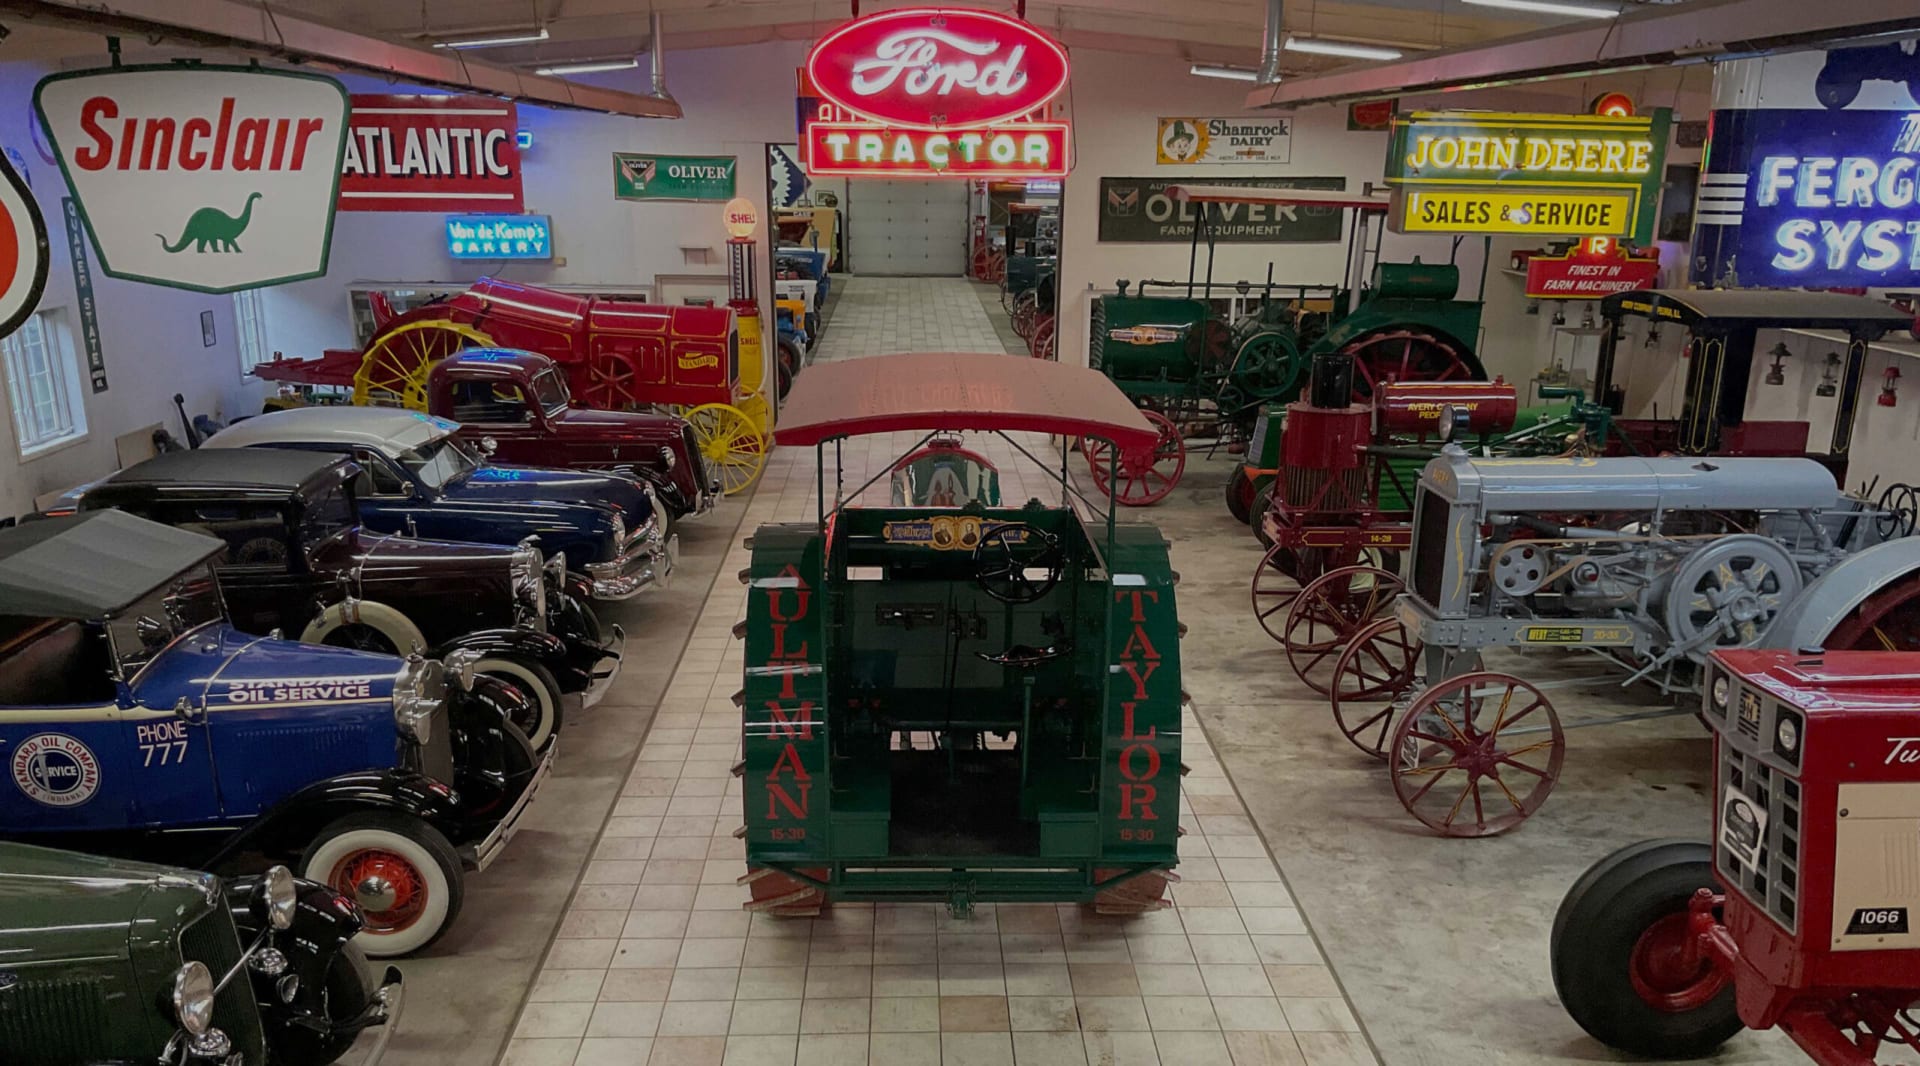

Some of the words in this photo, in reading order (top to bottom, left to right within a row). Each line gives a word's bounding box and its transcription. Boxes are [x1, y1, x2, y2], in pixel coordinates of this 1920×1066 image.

[852, 29, 1027, 96] Ford
[74, 96, 324, 171] Sinclair
[1208, 119, 1289, 136] Shamrock
[342, 127, 509, 176] ATLANTIC
[827, 134, 1050, 164] TRACTOR
[1230, 136, 1273, 147] DAIRY
[1407, 135, 1519, 171] JOHN
[1525, 138, 1653, 174] DEERE
[669, 165, 728, 179] OLIVER
[1756, 156, 1920, 208] FERG
[1145, 193, 1298, 222] OLIVER
[1422, 200, 1491, 224] SALES
[1500, 204, 1511, 222] &
[1519, 202, 1612, 226] SERVICE
[449, 222, 475, 239] Van
[1160, 225, 1195, 236] FARM
[1204, 225, 1283, 236] EQUIPMENT
[452, 242, 544, 254] BAKERY
[1567, 264, 1606, 276] FINEST
[1607, 265, 1622, 276] IN
[67, 201, 87, 288] QUAKER
[83, 297, 100, 366] STATE
[1543, 279, 1576, 290] FARM
[1407, 403, 1434, 411] AVERY
[228, 689, 270, 703] OIL
[274, 685, 371, 701] SERVICE
[765, 563, 816, 819] AULTMAN
[1114, 590, 1162, 820] TAYLOR
[137, 720, 188, 744] PHONE
[16, 742, 38, 796] STANDARD
[41, 736, 61, 748] OIL
[65, 740, 97, 792] COMPANY
[139, 740, 188, 768] 777
[34, 765, 78, 778] SRVICE
[1860, 910, 1900, 925] 1066
